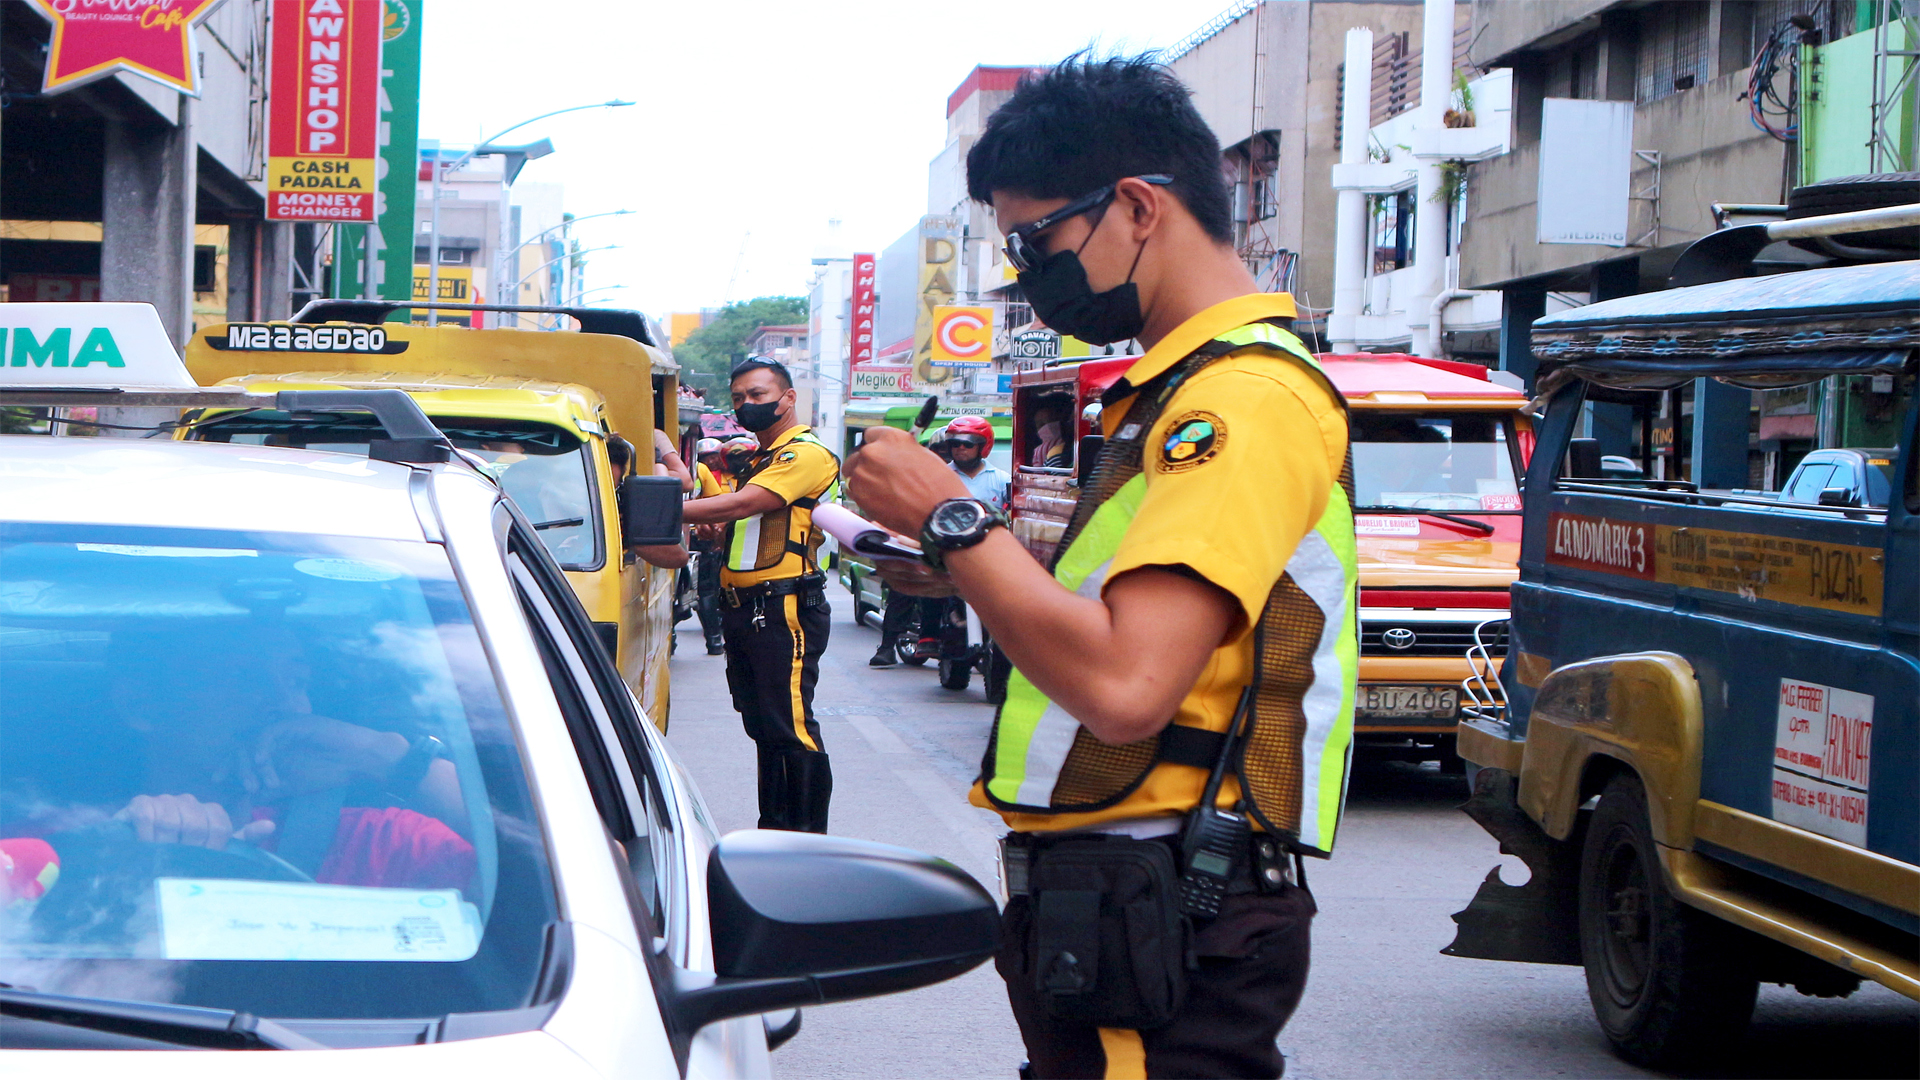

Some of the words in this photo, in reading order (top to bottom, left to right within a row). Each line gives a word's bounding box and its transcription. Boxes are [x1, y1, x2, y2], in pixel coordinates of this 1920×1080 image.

[65, 12, 97, 20] BEAUTY
[99, 13, 133, 21] LOUNGE
[291, 160, 350, 174] CASH
[279, 176, 362, 189] PADALA
[277, 192, 362, 206] MONEY
[277, 206, 362, 218] CHANGER
[1021, 332, 1051, 340] DAVAO
[1013, 340, 1057, 357] HOTEL
[856, 373, 896, 390] Megiko
[961, 408, 987, 416] CROSSING
[1356, 691, 1397, 710] BU
[1404, 692, 1453, 711] 406
